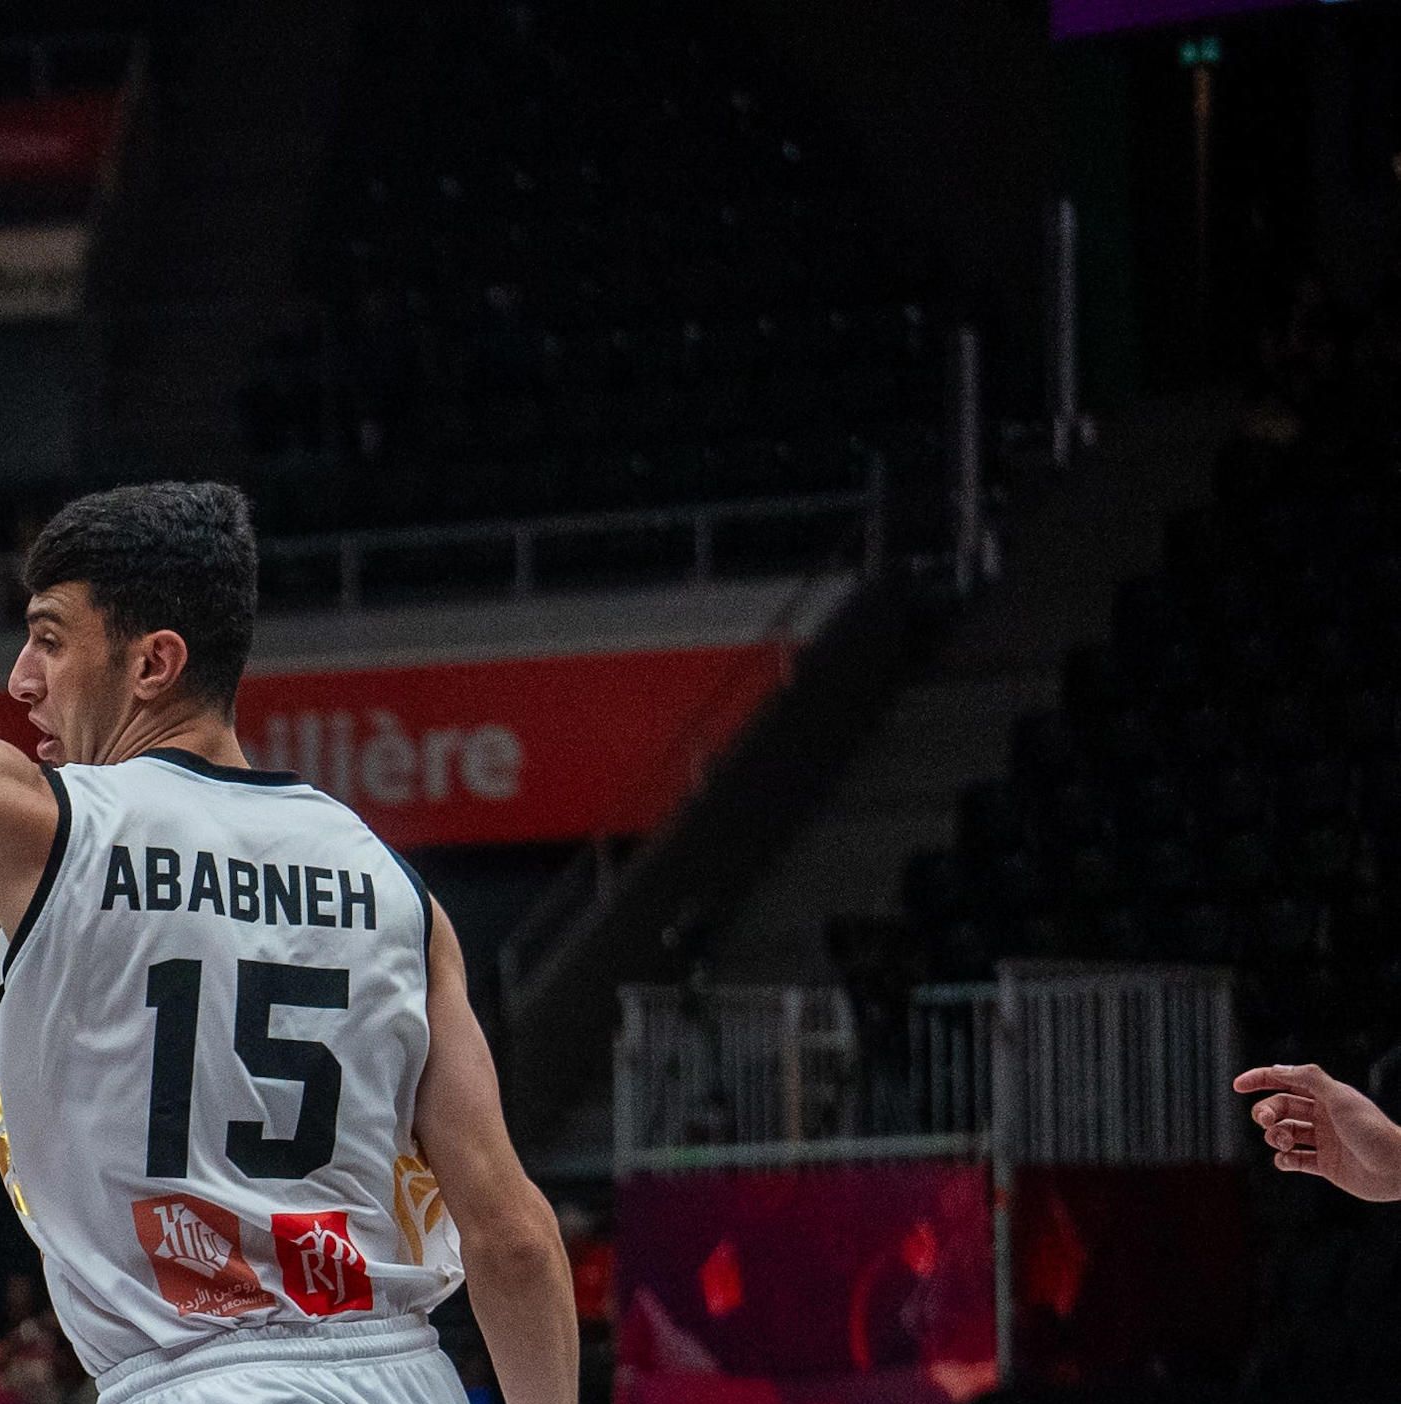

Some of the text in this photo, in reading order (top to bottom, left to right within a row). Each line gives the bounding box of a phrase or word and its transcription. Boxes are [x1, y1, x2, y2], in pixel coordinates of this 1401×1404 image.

[242, 709, 522, 803] ilière
[101, 845, 377, 931] ABABNEH
[145, 958, 350, 1180] 15
[300, 1249, 347, 1305] RJ
